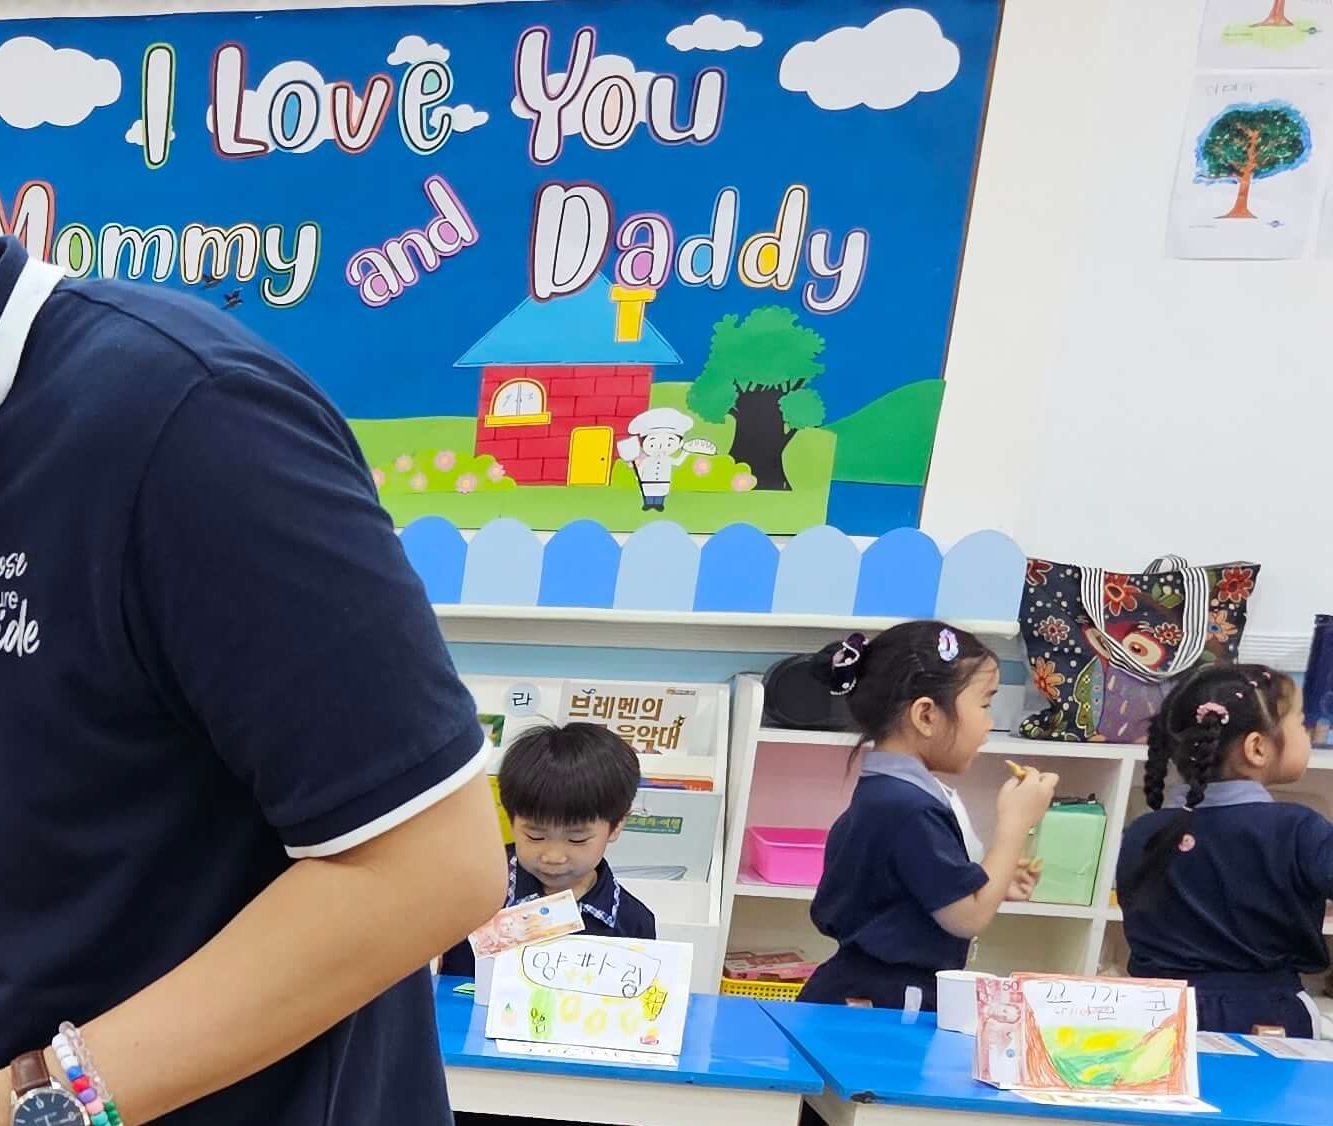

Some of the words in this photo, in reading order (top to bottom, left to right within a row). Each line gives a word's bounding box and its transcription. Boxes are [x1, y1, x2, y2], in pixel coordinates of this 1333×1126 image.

[141, 43, 175, 169] I
[212, 41, 454, 158] Love
[515, 25, 728, 166] You
[344, 175, 480, 309] and
[530, 180, 869, 314] Daddy
[511, 692, 533, 707] 라
[568, 694, 664, 722] 브레멘의
[617, 723, 683, 751] 음악대
[1002, 981, 1021, 992] 50
